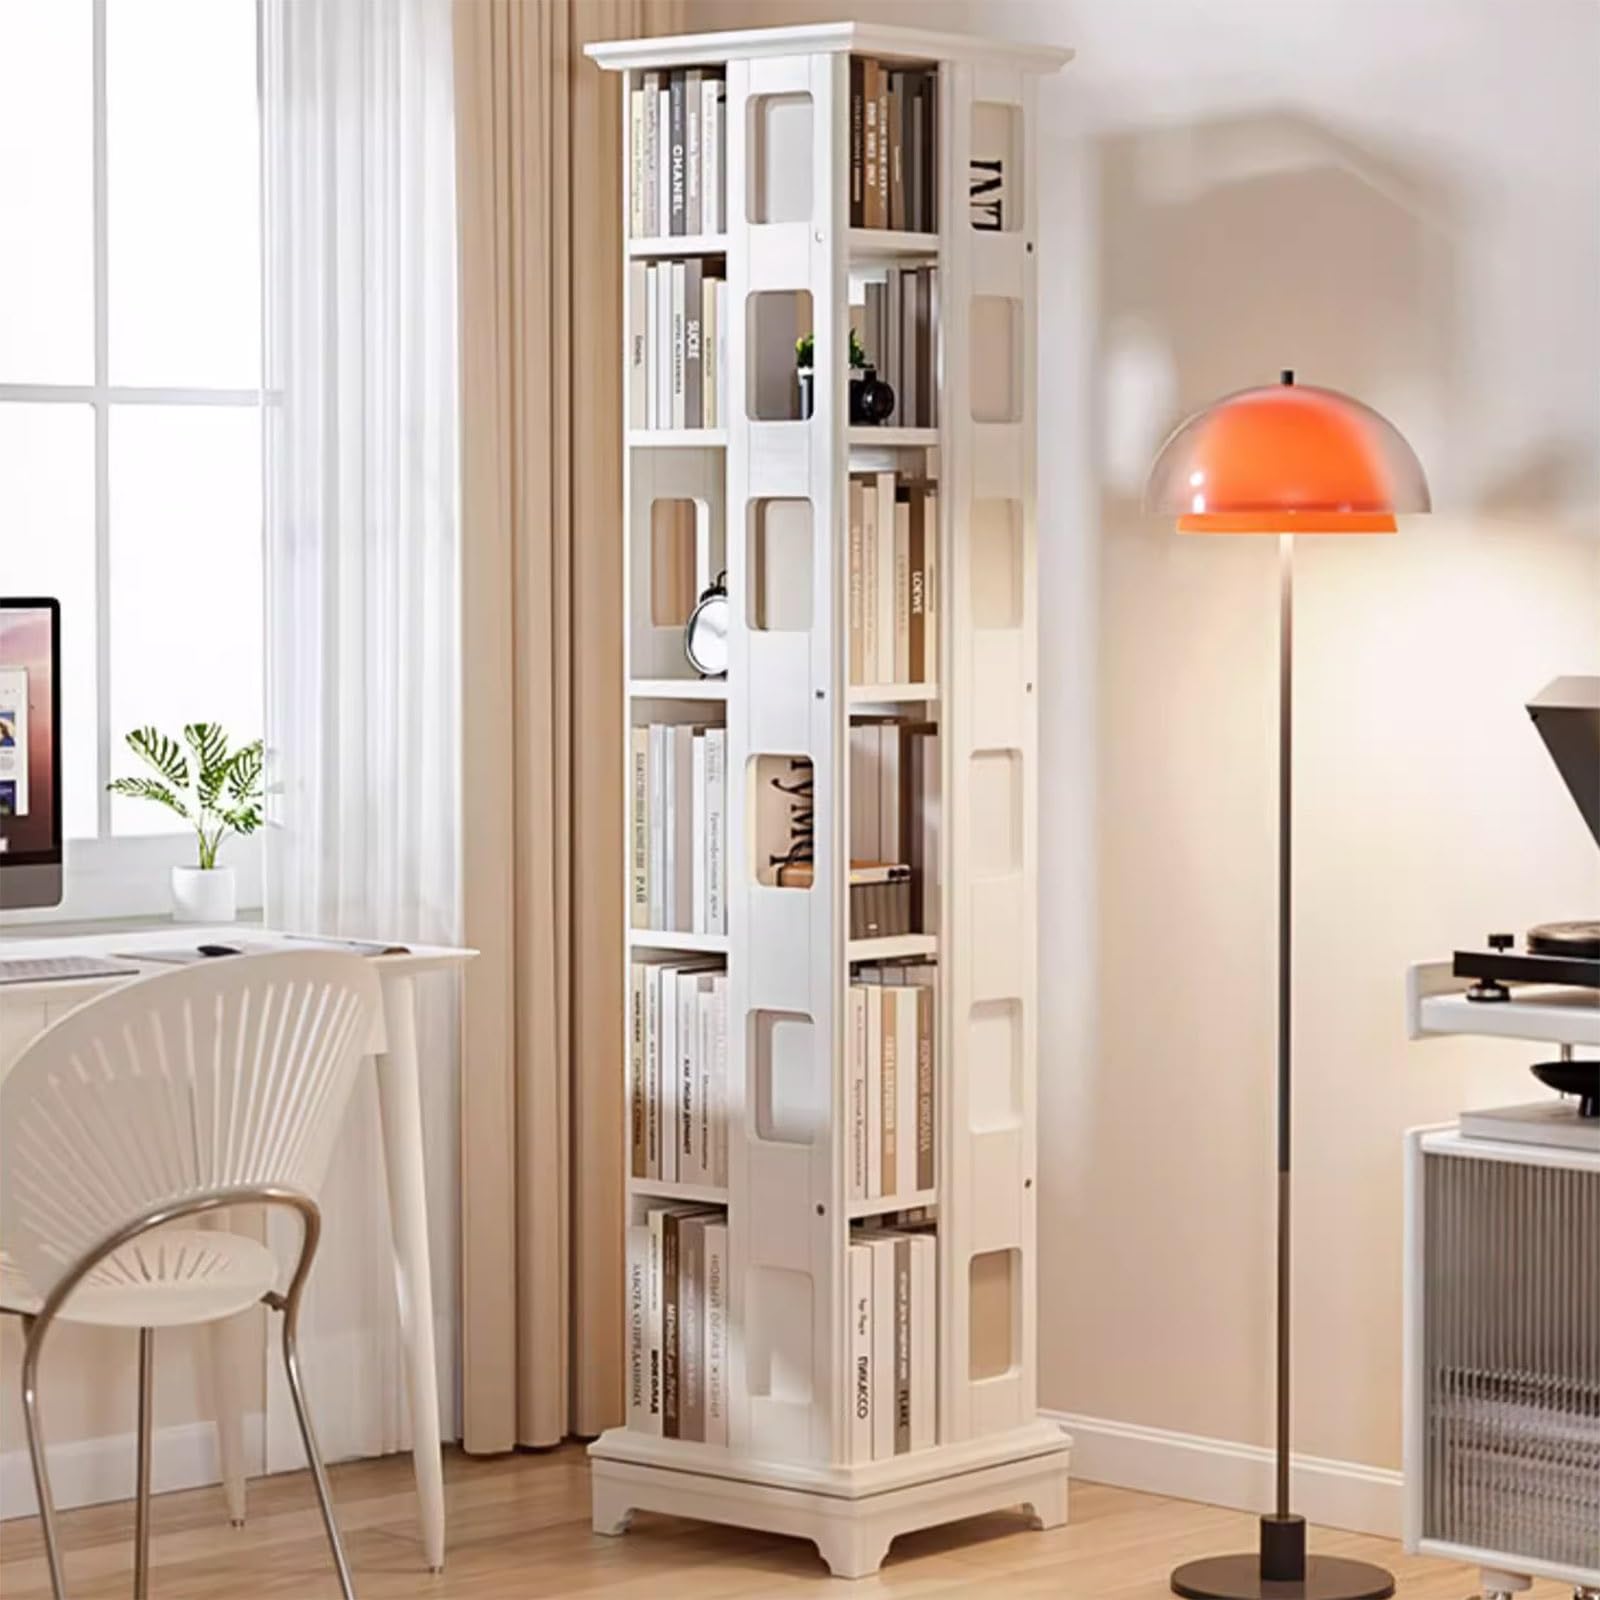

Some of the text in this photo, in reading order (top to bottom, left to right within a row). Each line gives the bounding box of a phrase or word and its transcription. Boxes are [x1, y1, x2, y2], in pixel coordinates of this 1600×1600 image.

[673, 144, 683, 215] CHANEL
[912, 571, 922, 614] LOEWE
[857, 1355, 869, 1419] ПИКАССО
